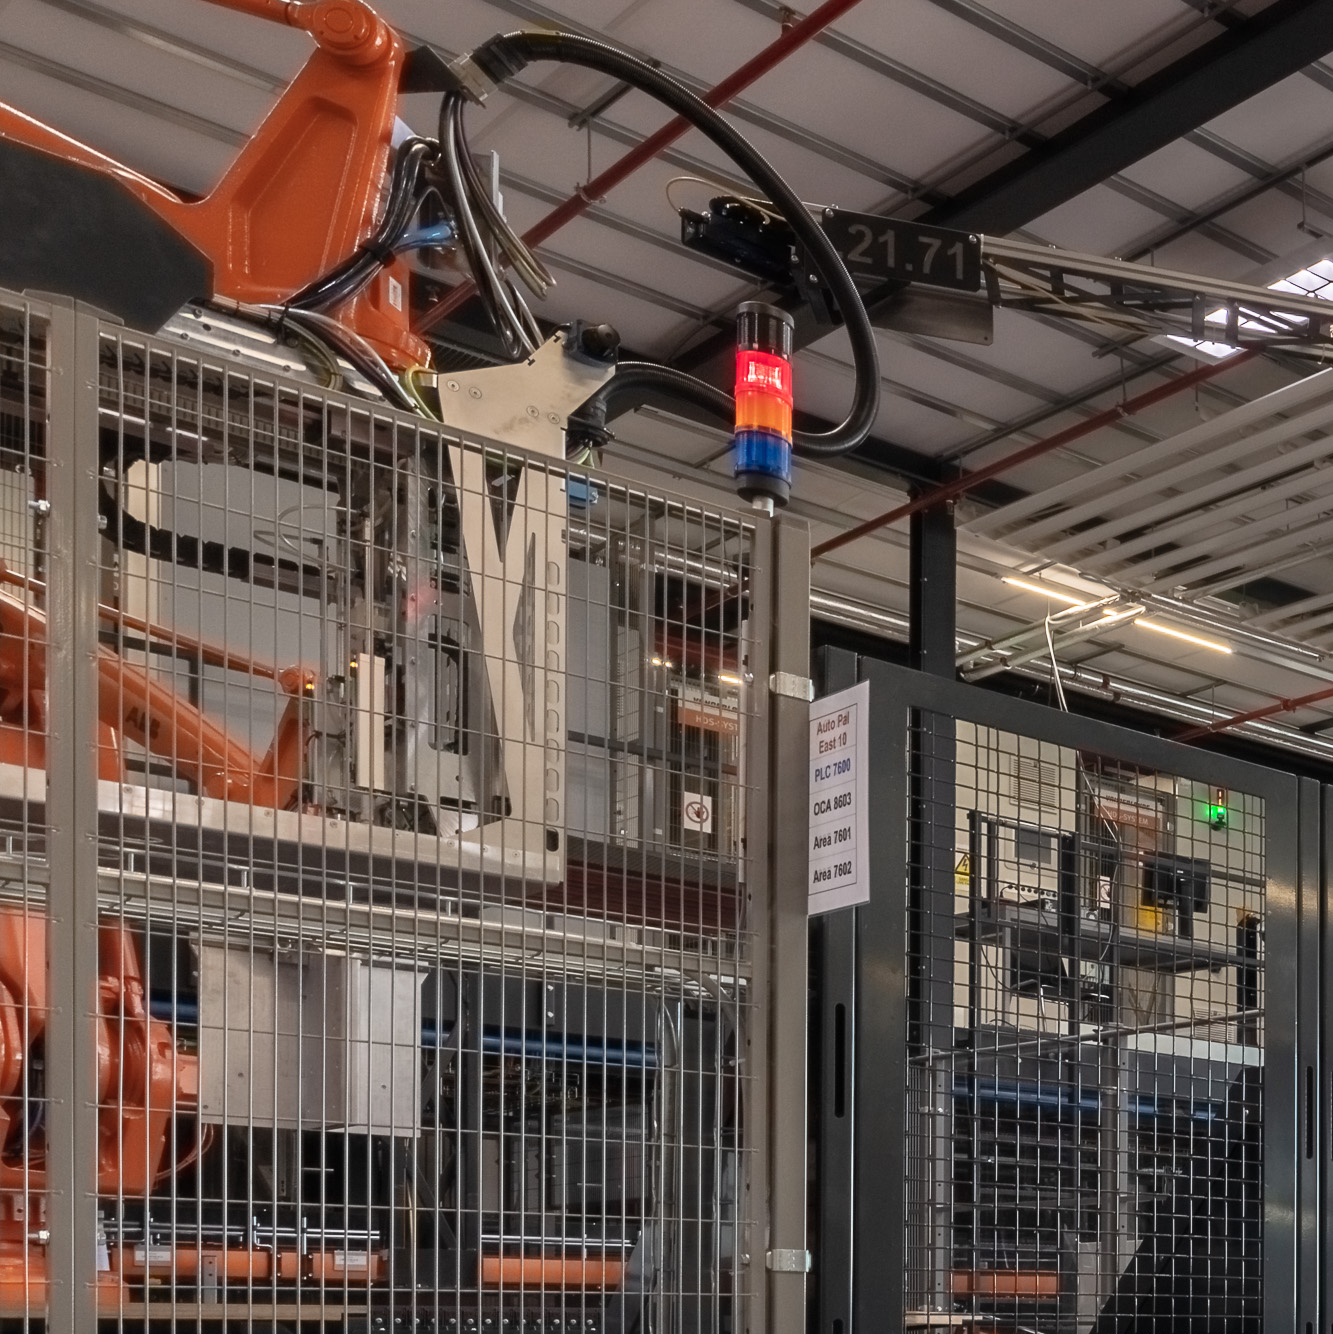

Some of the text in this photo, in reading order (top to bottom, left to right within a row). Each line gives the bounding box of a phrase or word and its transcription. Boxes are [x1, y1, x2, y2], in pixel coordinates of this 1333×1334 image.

[816, 711, 850, 736] Auto Pal
[818, 732, 847, 755] East 10
[814, 758, 851, 783] PLC 7600
[813, 792, 852, 816] OCA 8603
[813, 826, 851, 850] Area 7601
[812, 861, 852, 884] Area 7602
